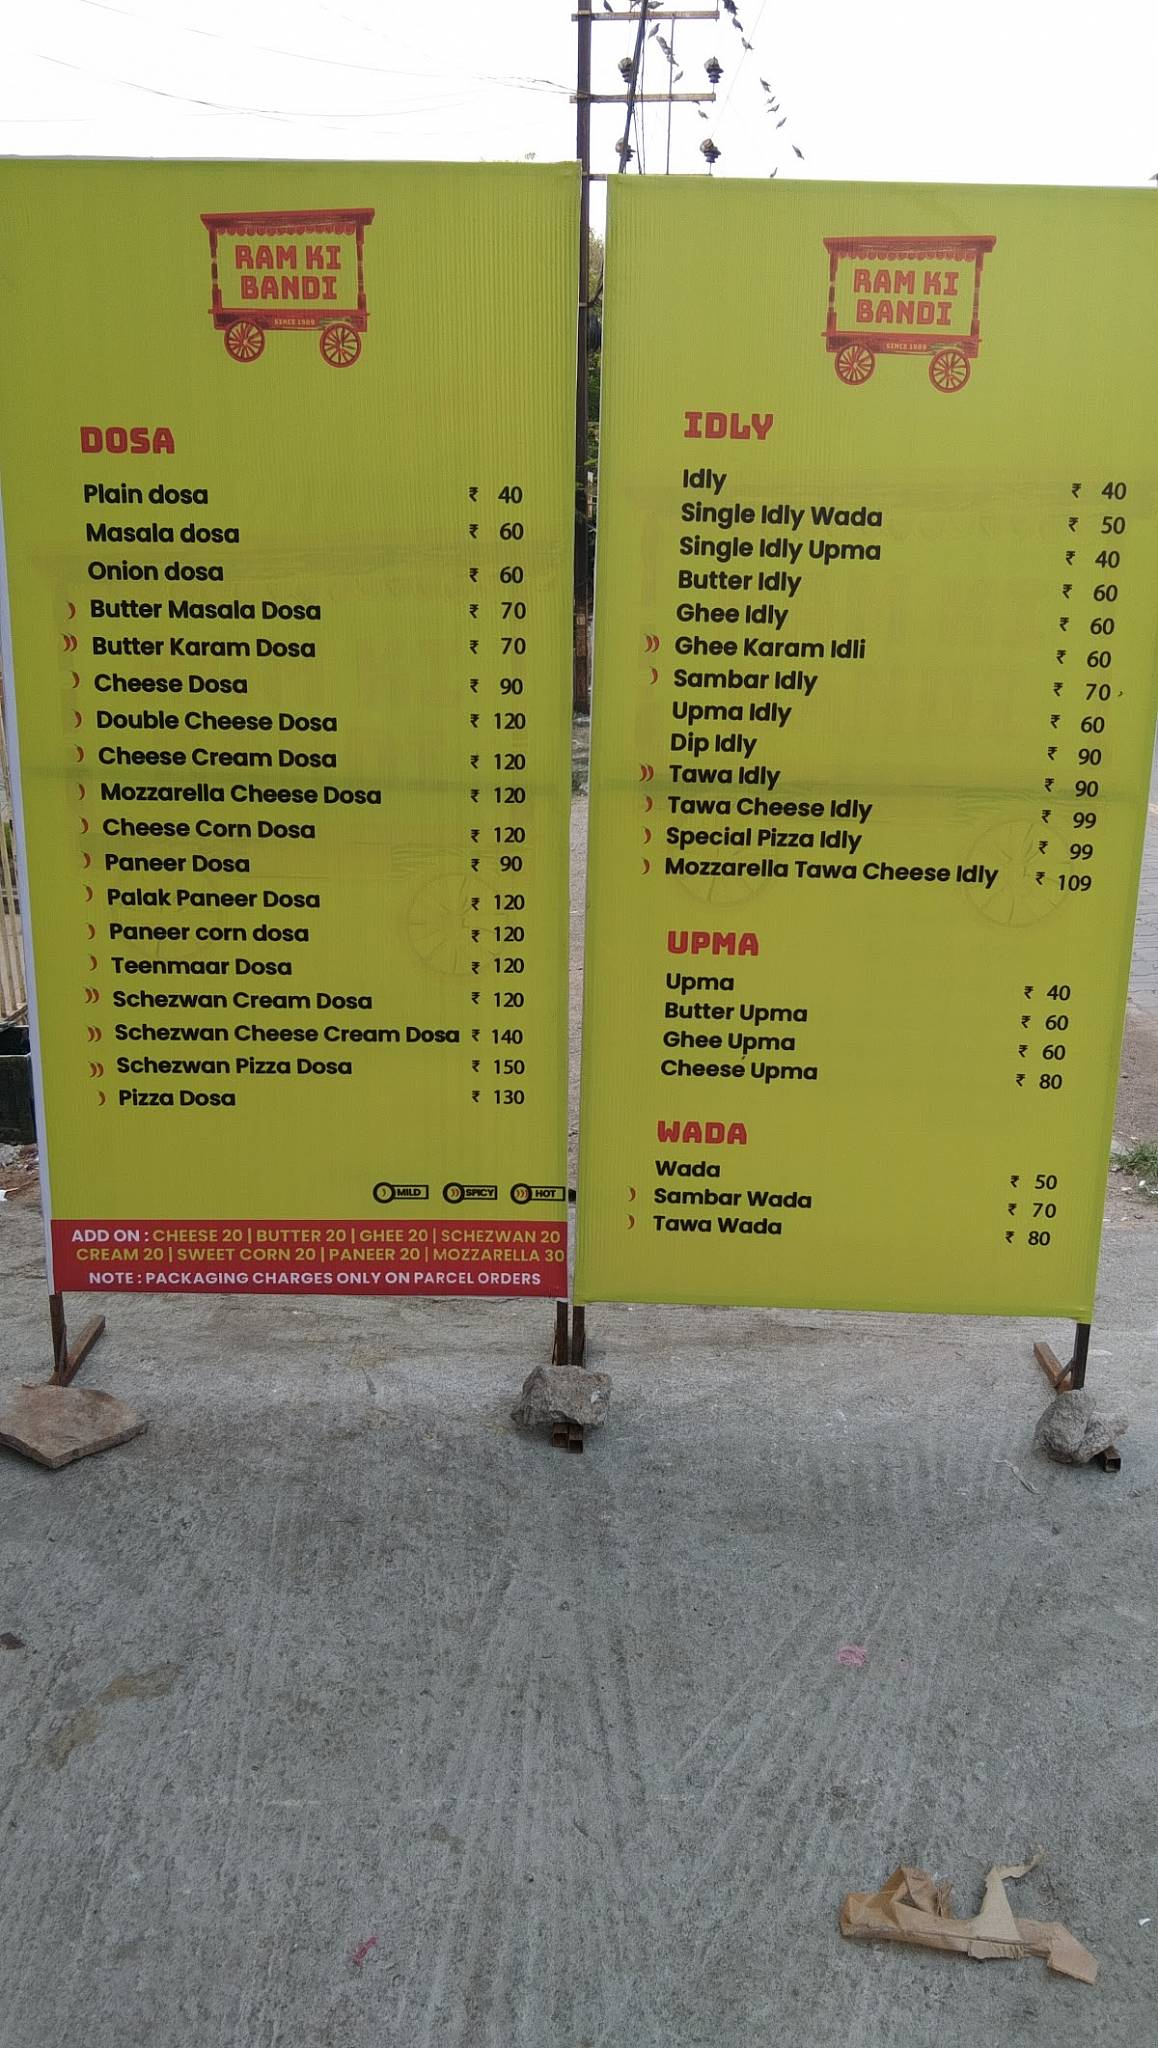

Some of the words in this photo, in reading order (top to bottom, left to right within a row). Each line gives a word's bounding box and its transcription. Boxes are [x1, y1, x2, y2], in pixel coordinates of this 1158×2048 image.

[235, 245, 297, 269] RAM
[306, 245, 341, 269] KI
[241, 275, 337, 299] BANDI
[853, 269, 916, 295] RAM
[923, 271, 959, 296] KI
[856, 299, 952, 325] BANDI
[684, 412, 773, 440] IDLY
[80, 427, 174, 454] DOSA
[84, 483, 143, 503] Plain
[148, 484, 208, 504] dosa
[498, 486, 522, 504] 40
[683, 468, 727, 495] Idly
[1102, 482, 1126, 500] 40
[682, 501, 755, 529] Single
[762, 504, 805, 531] Idly
[811, 506, 882, 527] Wada
[1101, 516, 1125, 534] 50
[86, 523, 174, 542] Masala
[180, 523, 239, 543] dosa
[500, 523, 523, 540] 60
[88, 560, 158, 580] Onion
[165, 561, 223, 581] dosa
[500, 566, 523, 583] 60
[678, 570, 753, 590] Butter
[758, 571, 802, 598] Idly
[1094, 584, 1118, 602] 60
[91, 599, 162, 618] Butter
[168, 600, 255, 619] Masala
[262, 601, 321, 620] Dosa
[501, 602, 526, 619] 70
[677, 603, 739, 623] Ghee
[746, 604, 789, 630] Idly
[1090, 618, 1114, 635] 60
[93, 637, 164, 655] Butter
[170, 638, 250, 656] Karam
[256, 639, 315, 657] Dosa
[501, 638, 526, 655] 70
[675, 636, 737, 656] Ghee
[744, 638, 824, 658] Karam
[831, 639, 866, 659] Idli
[1087, 651, 1111, 668] 60
[94, 673, 183, 692] Cheese
[189, 675, 247, 693] Dosa
[500, 678, 523, 695] 90
[674, 669, 769, 689] Sambar
[775, 671, 818, 696] Idly
[1086, 683, 1110, 701] 70
[97, 710, 179, 729] Double
[185, 711, 273, 730] Cheese
[279, 713, 337, 732] Dosa
[494, 713, 526, 729] 120
[671, 732, 709, 757] Dip
[715, 734, 757, 759] Idly
[1079, 749, 1101, 765] 90
[669, 765, 732, 784] Tawa
[739, 766, 781, 791] Idly
[1075, 780, 1098, 797] 90
[101, 783, 224, 802] Mozzarella
[231, 784, 318, 803] Cheese
[324, 786, 381, 804] Dosa
[494, 787, 525, 803] 120
[668, 796, 730, 815] Tawa
[737, 797, 824, 817] Cheese
[831, 799, 873, 824] Idly
[1073, 812, 1096, 829] 99
[103, 818, 190, 837] Cheese
[196, 820, 251, 837] Corn
[258, 821, 315, 839] Dosa
[494, 827, 525, 843] 120
[105, 854, 186, 871] Paneer
[193, 855, 249, 872] Dosa
[500, 856, 522, 872] 90
[665, 857, 788, 877] Mozzarella
[795, 861, 857, 879] Tawa
[863, 862, 950, 882] Cheese
[956, 865, 999, 889] Idly
[1059, 875, 1092, 891] 109
[108, 888, 171, 906] Palak
[177, 889, 258, 907] Paneer
[263, 891, 320, 908] Dosa
[494, 894, 525, 910] 120
[668, 931, 758, 956] UPMA
[111, 957, 230, 974] Teenmaar
[235, 958, 292, 975] Dosa
[494, 958, 524, 973] 120
[113, 990, 227, 1008] Schezwan
[233, 992, 310, 1009] Cream
[317, 993, 372, 1009] Dosa
[494, 992, 524, 1007] 120
[665, 1002, 735, 1020] Butter
[740, 1004, 807, 1026] Upma
[1046, 1015, 1068, 1030] 60
[115, 1024, 228, 1041] Schezwan
[234, 1025, 318, 1042] Cheese
[324, 1026, 400, 1042] Cream
[406, 1027, 459, 1043] Dosa
[492, 1029, 523, 1044] 140
[663, 1031, 722, 1048] Ghee
[728, 1033, 795, 1055] Upma
[1043, 1045, 1065, 1060] 60
[117, 1056, 230, 1073] Schezwan
[236, 1056, 291, 1074] Pizza
[297, 1058, 352, 1074] Dosa
[494, 1059, 525, 1074] 150
[661, 1059, 745, 1077] Cheese
[751, 1062, 817, 1084] Upma
[1039, 1074, 1062, 1089] 80
[119, 1088, 174, 1106] Pizza
[180, 1090, 236, 1106] Dosa
[494, 1090, 524, 1104] 130
[658, 1121, 747, 1145] WADA
[655, 1160, 720, 1178] Wada
[1035, 1174, 1057, 1190] 50
[397, 1184, 421, 1196] MILD
[466, 1185, 495, 1197] SPICY
[535, 1187, 556, 1198] HOT
[654, 1188, 742, 1206] Sambar
[747, 1191, 812, 1208] Wada
[1033, 1203, 1056, 1218] 70
[71, 1229, 110, 1243] ADD
[113, 1229, 140, 1243] ON
[153, 1229, 218, 1243] CHEESE
[222, 1229, 243, 1243] 20
[256, 1229, 321, 1243] BUTTER
[326, 1229, 346, 1243] 20
[360, 1229, 404, 1243] GHEE
[408, 1229, 428, 1244] 20
[441, 1230, 536, 1244] SCHEZWAN
[540, 1230, 561, 1245] 20
[653, 1216, 711, 1232] Tawa
[718, 1217, 782, 1235] Wada
[1028, 1231, 1050, 1246] 80
[76, 1248, 139, 1262] CREAM
[143, 1248, 164, 1262] 20
[177, 1248, 235, 1262] SWEET
[239, 1248, 290, 1262] CORN
[295, 1248, 315, 1262] 20
[329, 1248, 396, 1262] PANEER
[399, 1248, 420, 1262] 20
[433, 1249, 541, 1263] MOZZARELLA
[544, 1249, 565, 1263] 30
[89, 1272, 134, 1285] NOTE
[145, 1272, 249, 1286] PACKAGING
[252, 1272, 333, 1286] CHARGES
[336, 1272, 381, 1286] ONLY
[385, 1272, 411, 1285] ON
[414, 1272, 474, 1286] PARCEL
[478, 1273, 542, 1286] ORDERS
